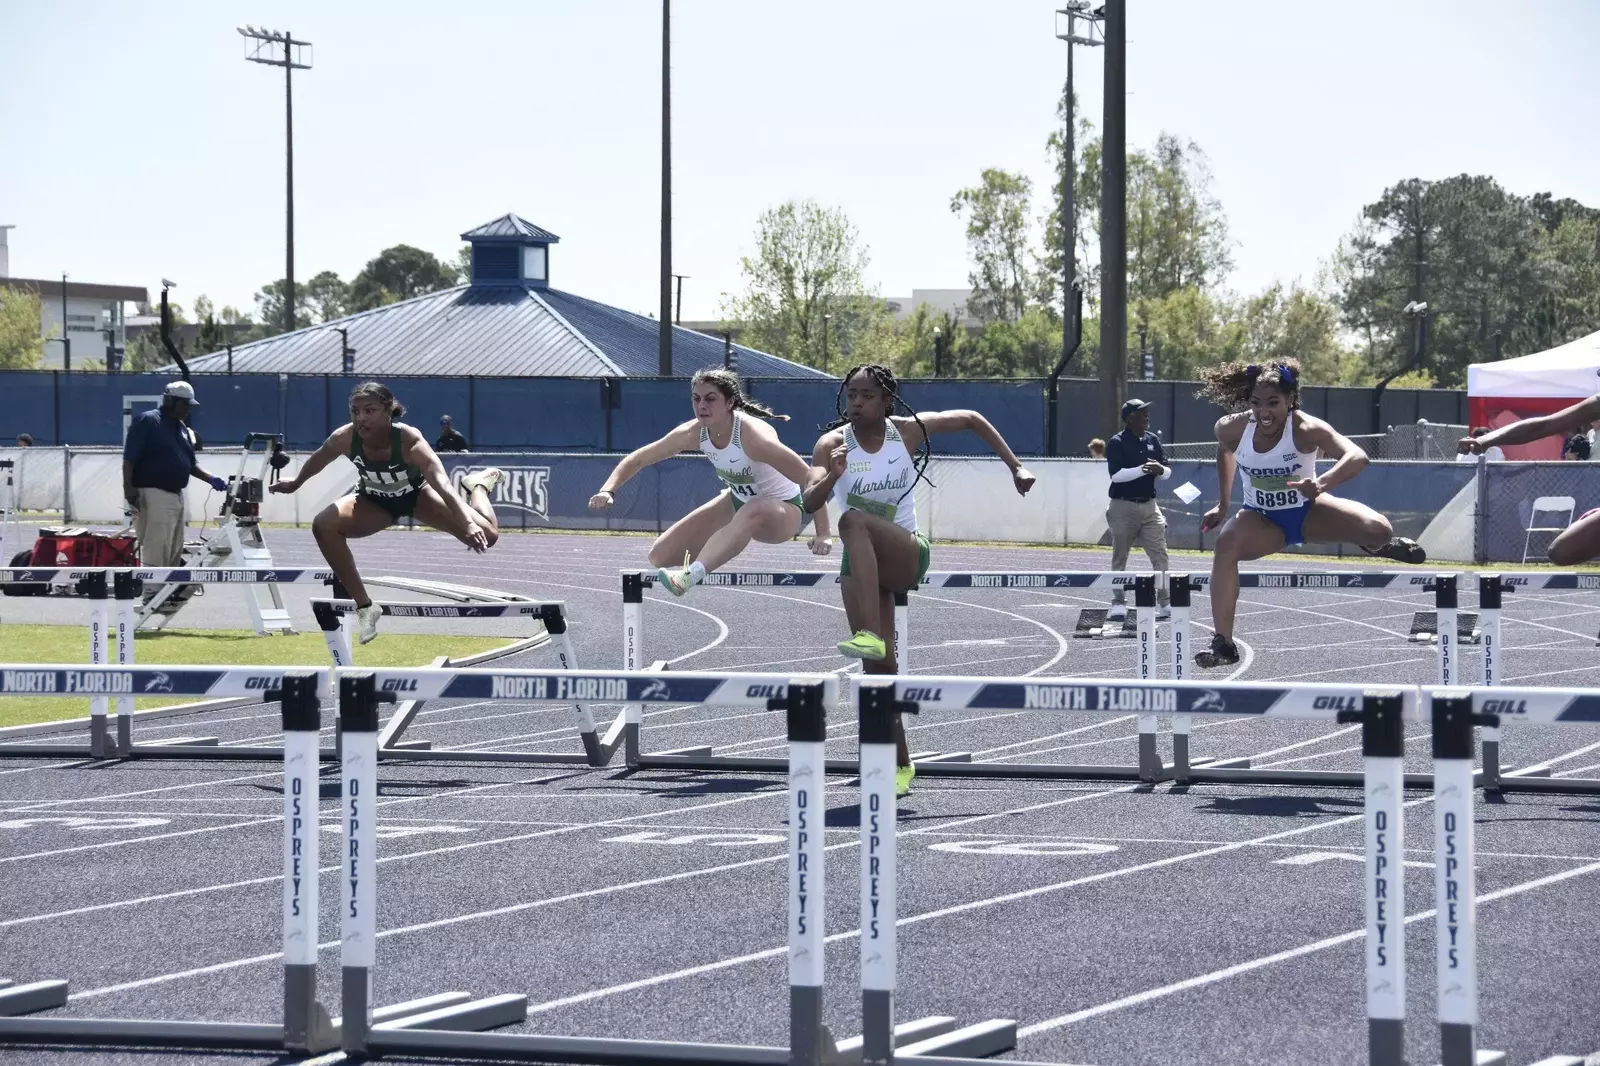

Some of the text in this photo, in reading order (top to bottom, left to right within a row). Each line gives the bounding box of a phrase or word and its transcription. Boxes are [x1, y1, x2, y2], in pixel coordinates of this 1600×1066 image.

[849, 461, 872, 474] SBC
[847, 468, 909, 495] Marshall
[451, 466, 549, 516] OREYS
[1255, 490, 1299, 508] 6898
[69, 572, 89, 580] GILL
[135, 572, 154, 580] GILL
[190, 570, 257, 582] NORTH FLORIDA
[313, 572, 334, 580] GILL
[644, 575, 661, 583] GIL
[702, 573, 774, 585] NORTH FLORIDA
[970, 574, 1047, 587] NORTH FLORIDA
[1111, 577, 1134, 585] GILL
[1192, 576, 1210, 585] GIL
[1258, 574, 1339, 587] NORTH FLORIDA
[1409, 577, 1433, 585] GILL
[1504, 577, 1529, 586] GILL
[1577, 575, 1600, 589] NOR
[388, 605, 459, 617] NORTH FLORIDA
[2, 671, 133, 692] NORTH FLORIDA
[244, 676, 282, 690] GILL
[381, 678, 418, 691] GILL
[491, 675, 628, 700] NORTH FLORIDA
[745, 684, 786, 698] GILL
[902, 687, 943, 701] GILL
[1024, 685, 1177, 711] NORTH FLORIDA
[1312, 695, 1356, 711] GILL
[1480, 699, 1527, 714] GILL
[291, 778, 301, 916] OSPREYS
[349, 778, 359, 918] OSPREYS
[797, 790, 808, 935] OSPREYS
[869, 793, 880, 940] OSPREYS
[1375, 810, 1387, 967] OSPREYS
[1444, 812, 1458, 969] OSPREYS
